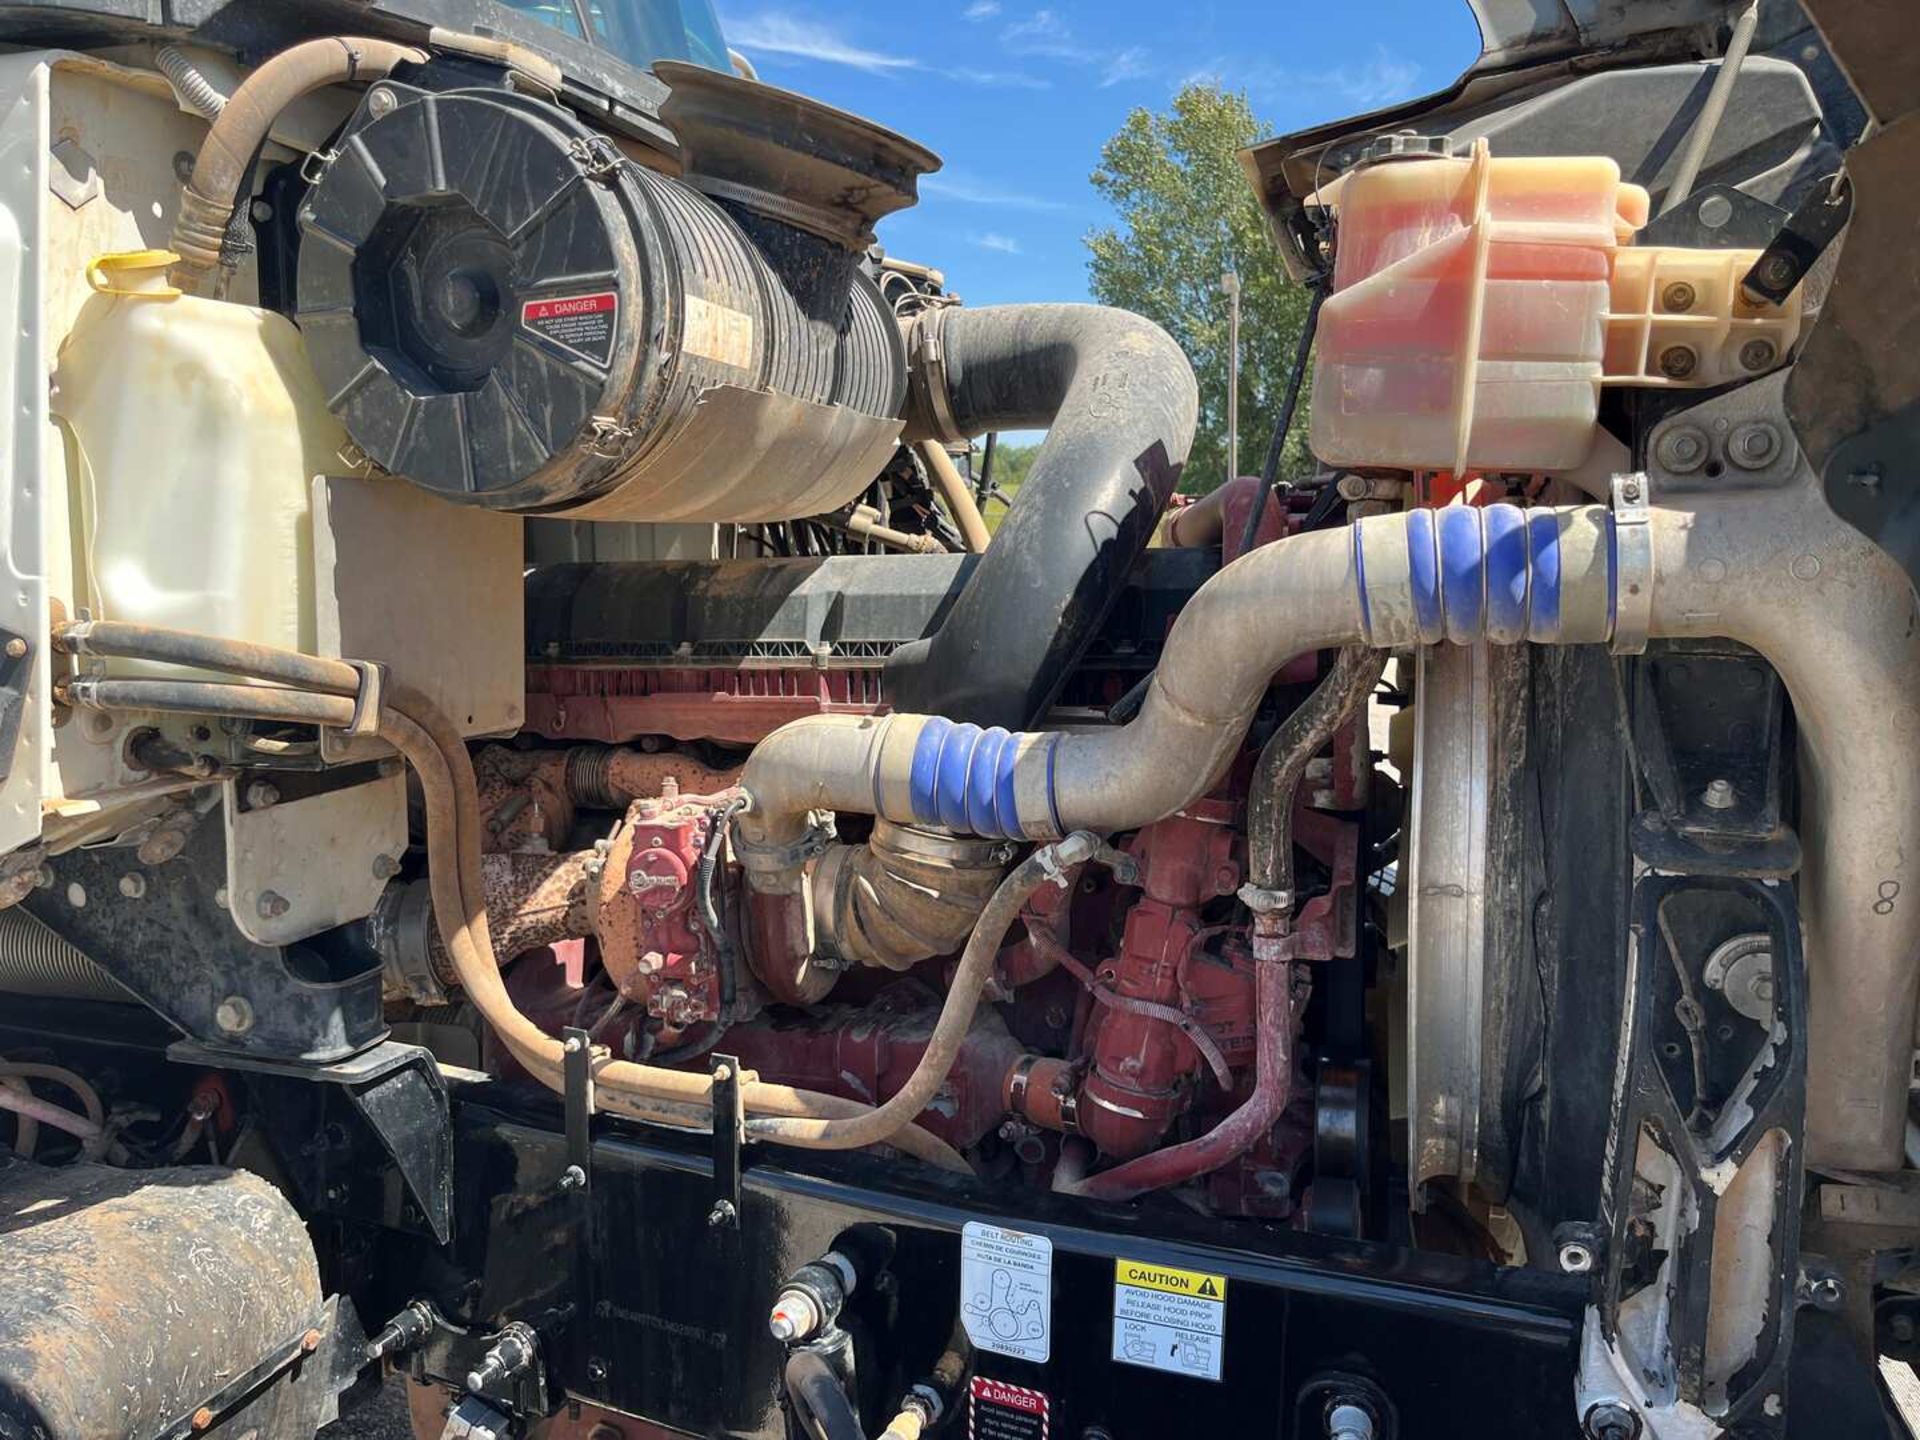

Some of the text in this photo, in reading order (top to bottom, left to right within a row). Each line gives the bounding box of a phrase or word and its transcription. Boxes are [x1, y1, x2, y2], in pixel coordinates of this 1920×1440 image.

[554, 299, 597, 314] DANGER
[981, 1229, 999, 1240] BELT
[1128, 1268, 1190, 1289] CAUTION
[1125, 1288, 1150, 1299] AVOID
[1151, 1291, 1176, 1303] HOOD
[1126, 1298, 1213, 1320] RELEASE HOOD PROP
[1119, 1308, 1216, 1332] BEFORE CLOSING HOOD
[1125, 1322, 1147, 1332] LOCK
[1175, 1331, 1212, 1344] RELEASE
[993, 1388, 1037, 1409] DANGER
